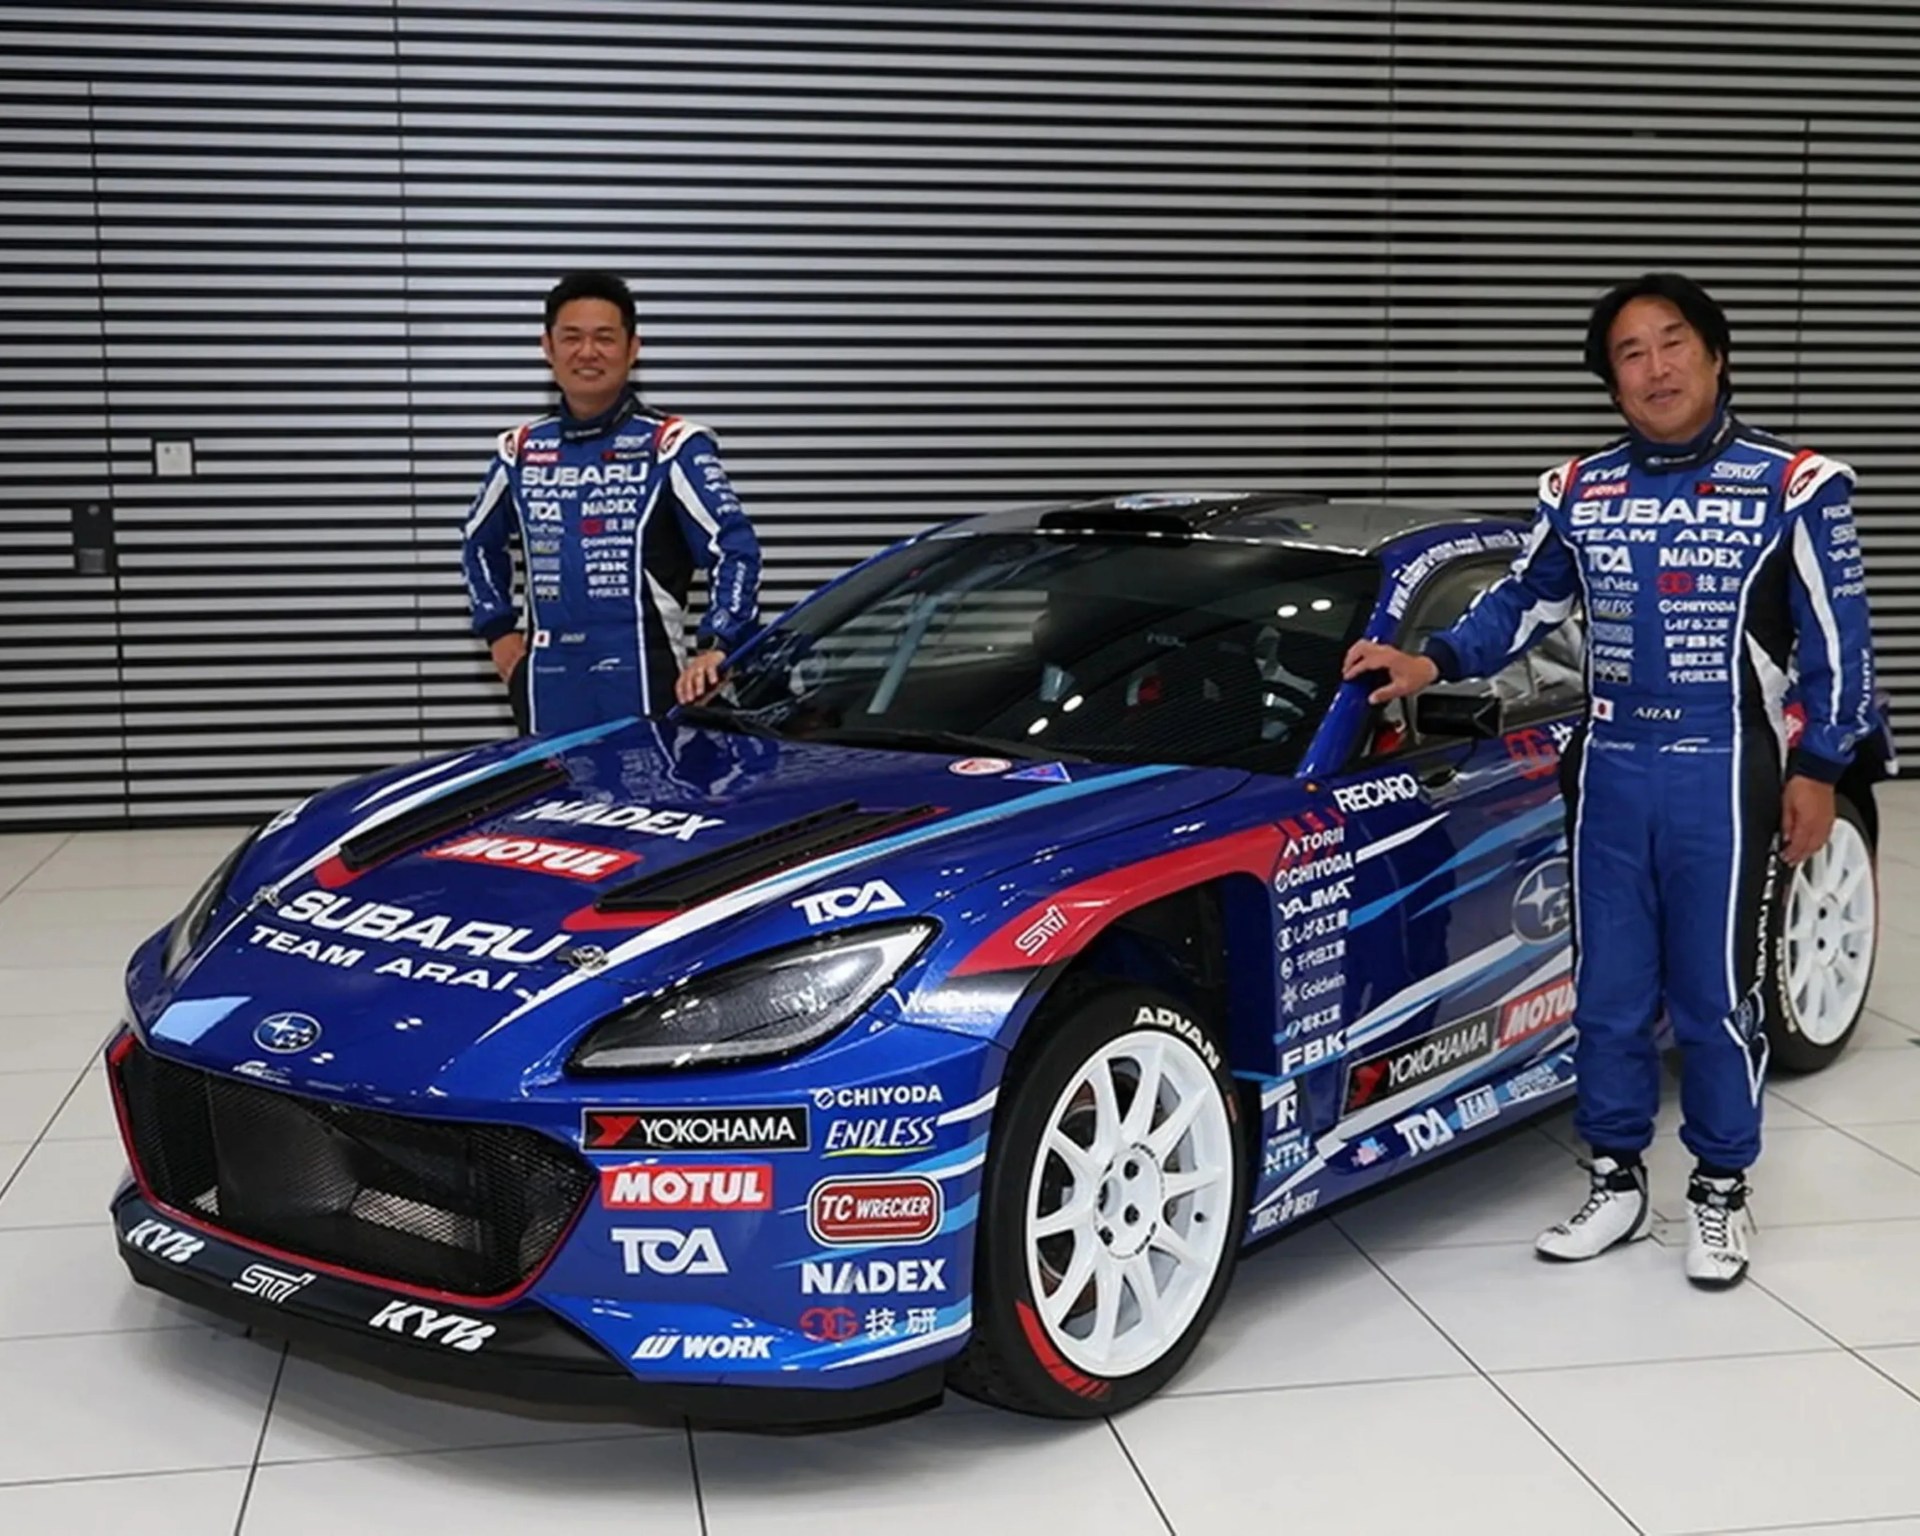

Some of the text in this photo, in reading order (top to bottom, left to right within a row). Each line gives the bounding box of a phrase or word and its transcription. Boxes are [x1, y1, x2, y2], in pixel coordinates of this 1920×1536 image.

[521, 461, 648, 487] SUBARU
[520, 485, 647, 499] TEAM ARAI
[1570, 498, 1767, 527] SUBARU
[1570, 528, 1763, 546] TEAM ARAI
[1659, 547, 1744, 568] NADEX
[1664, 635, 1727, 648] FBK
[1633, 706, 1682, 720] ARAI
[1333, 773, 1419, 813] RECARO
[516, 800, 724, 841] NADEX
[439, 837, 620, 877] MOTUL
[1278, 876, 1356, 920] YAJIMA
[279, 890, 572, 964] SUBARU
[248, 925, 522, 993] TEAM ARAI
[1133, 1005, 1221, 1070] ADVAN
[1282, 1029, 1348, 1076] FBK
[1387, 1021, 1488, 1088] YOKOHAMA
[1504, 982, 1577, 1040] MOTU
[837, 1085, 943, 1108] CHIYODA
[641, 1115, 797, 1143] YOKOHAMA
[824, 1116, 937, 1150] ENDLESS
[1264, 1134, 1310, 1177] NTN
[609, 1170, 765, 1205] MOTUL
[820, 1194, 931, 1221] TC WRECKER
[125, 1218, 206, 1264] KYB
[801, 1258, 947, 1294] NADEX
[369, 1299, 498, 1352] KYB
[683, 1335, 776, 1360] WORK
